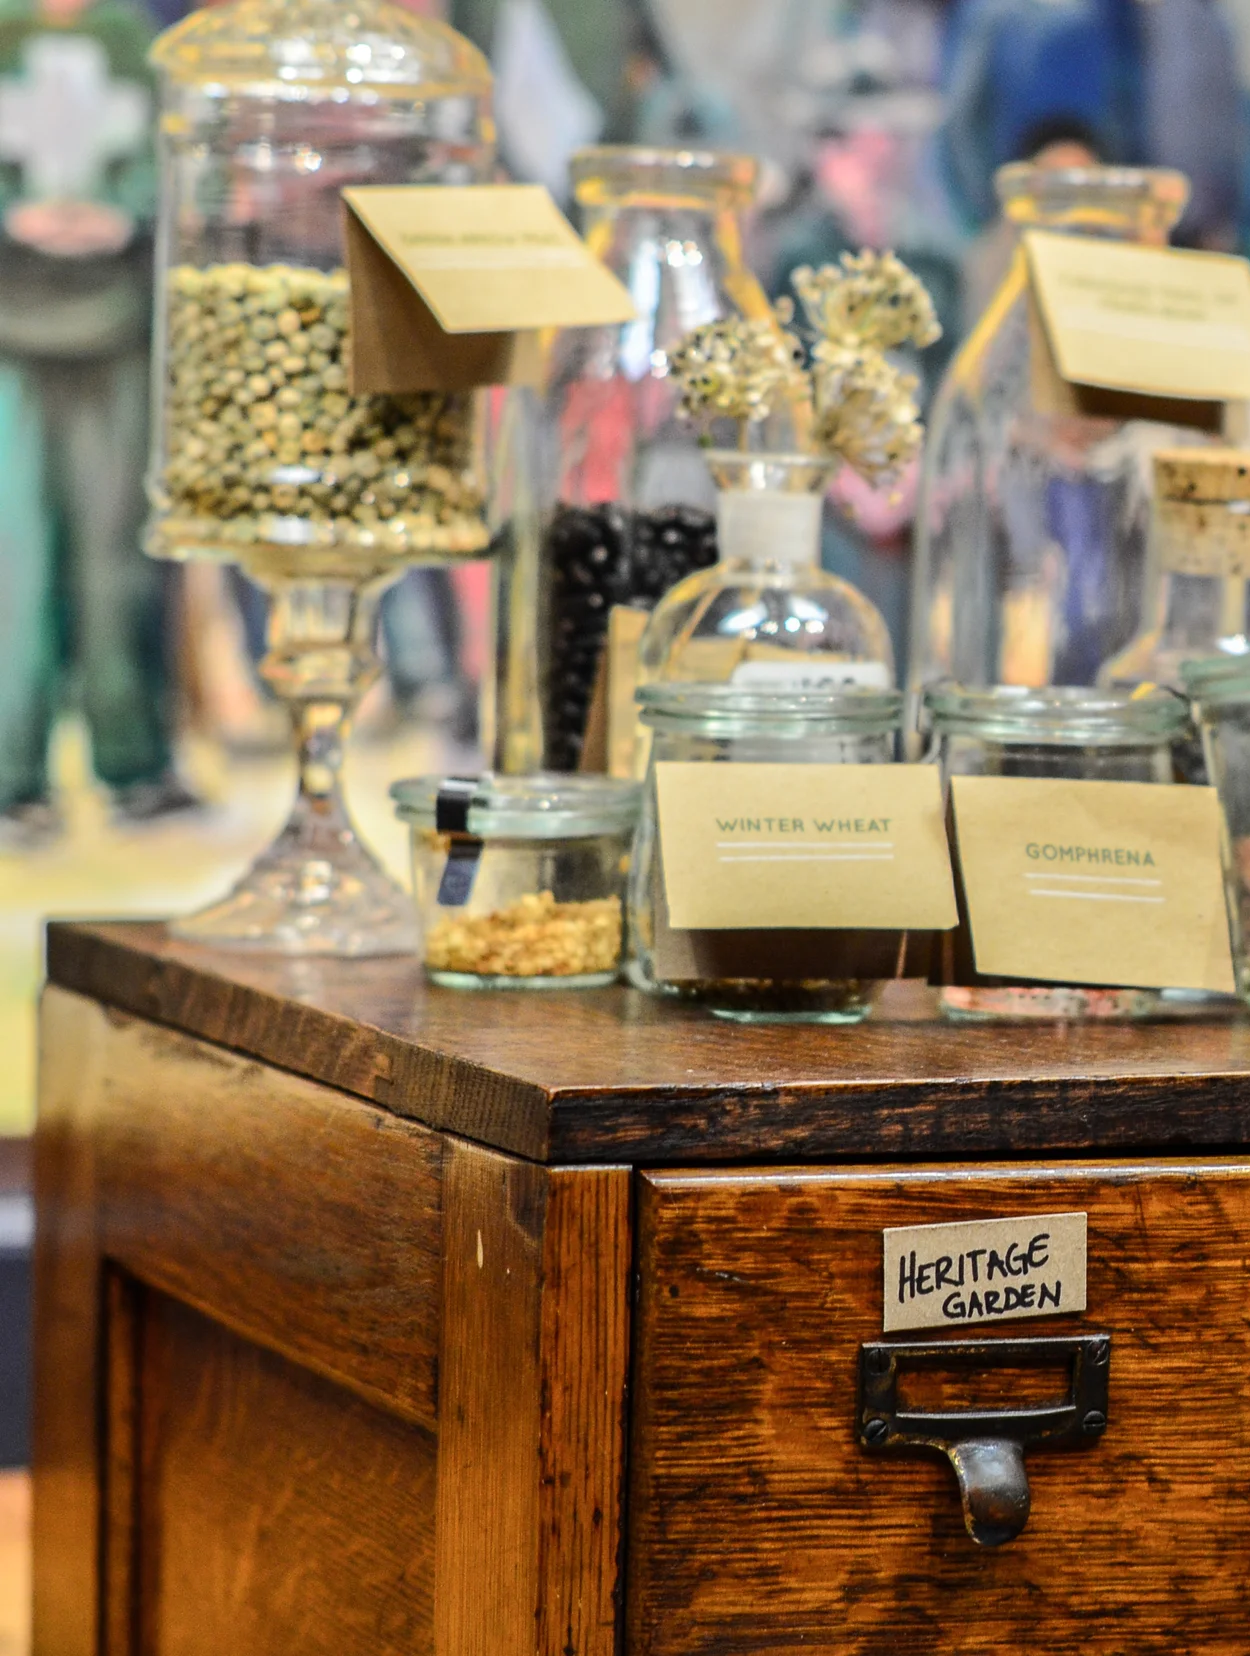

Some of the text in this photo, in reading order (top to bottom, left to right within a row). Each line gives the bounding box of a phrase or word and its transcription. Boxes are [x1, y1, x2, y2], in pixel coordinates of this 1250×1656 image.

[716, 817, 892, 833] WINTER WHEAT
[1025, 842, 1156, 867] GOMPHRENA
[898, 1233, 1050, 1304] HERITAGE
[942, 1280, 1062, 1319] GARDEN
